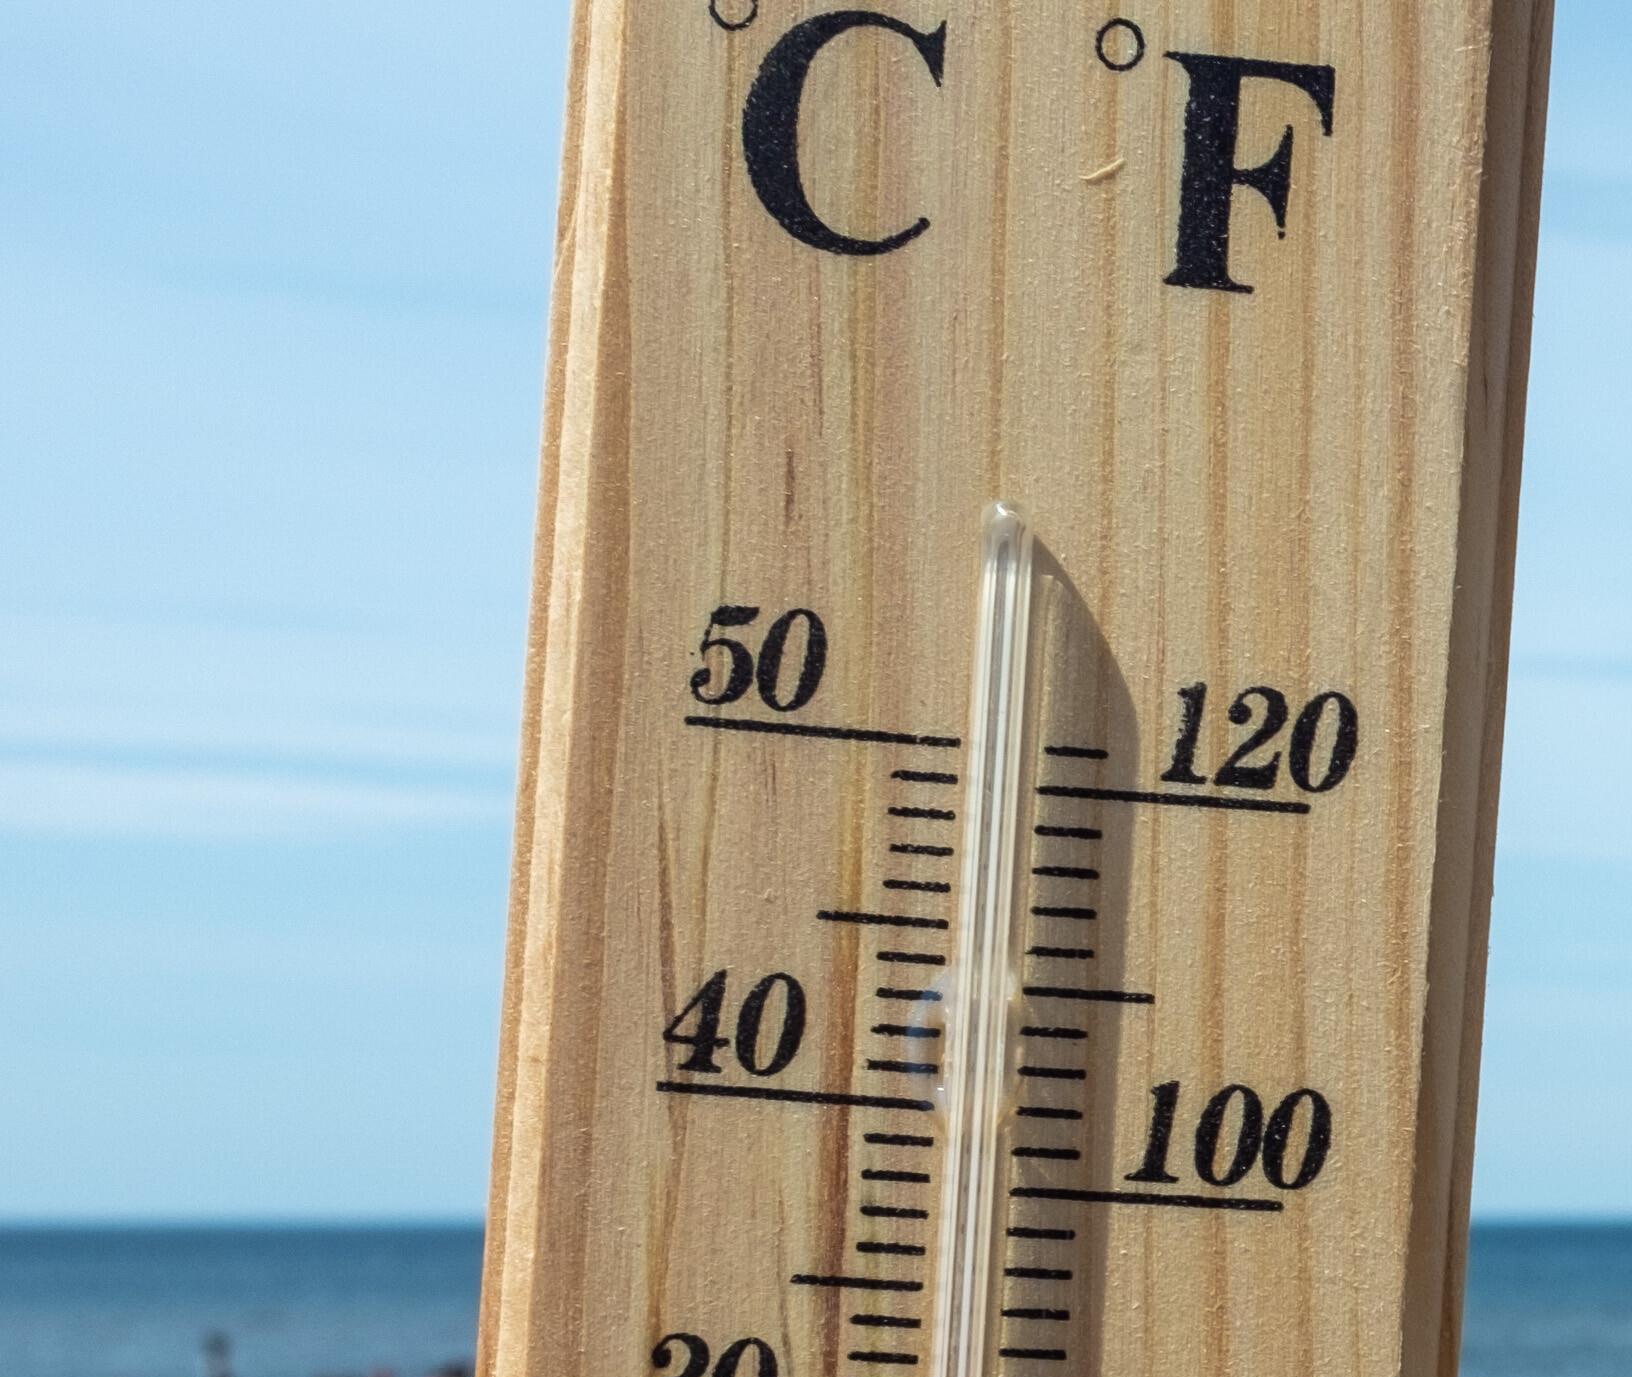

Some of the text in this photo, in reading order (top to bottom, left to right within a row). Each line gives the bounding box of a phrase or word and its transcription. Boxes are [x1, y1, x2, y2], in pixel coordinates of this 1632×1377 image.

[689, 605, 828, 713] 50
[1160, 682, 1359, 794] 120
[662, 969, 807, 1077] 40
[1123, 1080, 1333, 1191] 100
